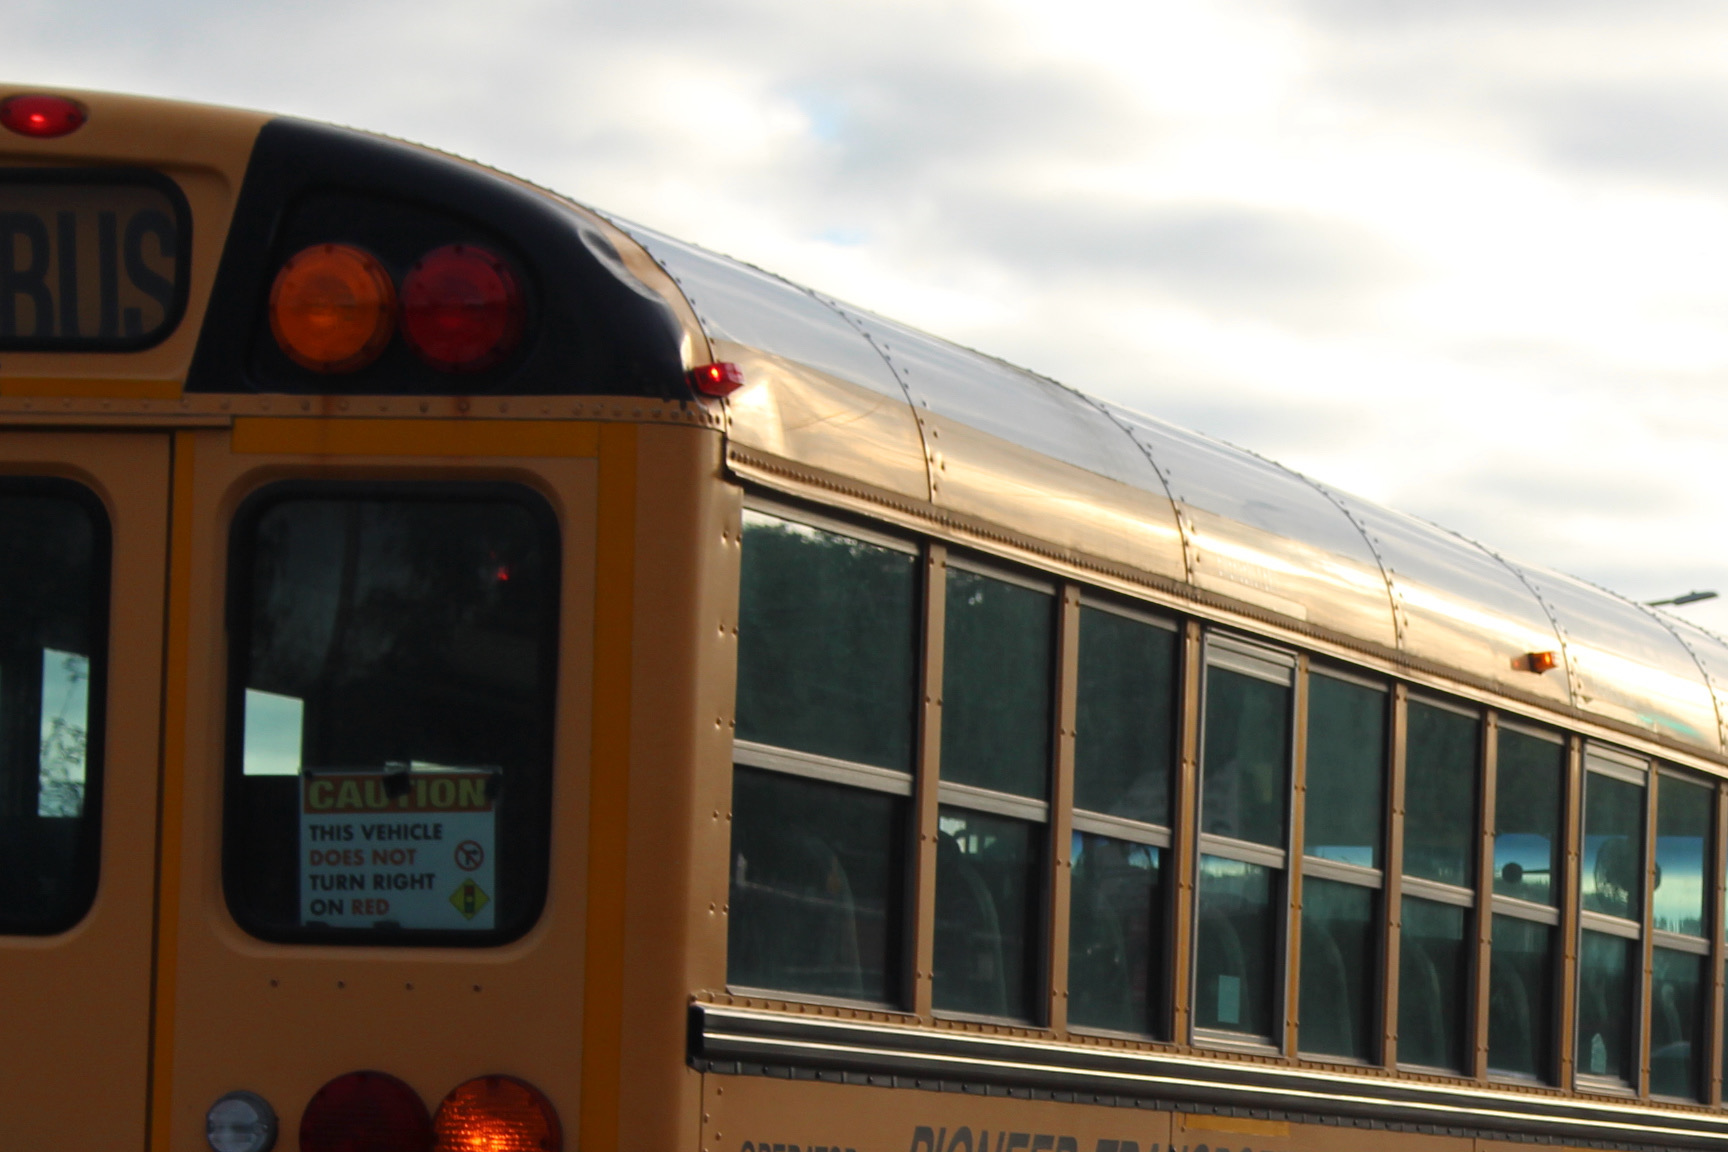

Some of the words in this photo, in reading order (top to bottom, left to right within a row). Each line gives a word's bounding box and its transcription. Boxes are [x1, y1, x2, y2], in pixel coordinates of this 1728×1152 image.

[0, 210, 177, 337] BUS
[309, 824, 354, 841] THIS
[361, 823, 443, 841] VEHICLE
[309, 849, 364, 866] DOES
[372, 849, 416, 866] NOT
[309, 874, 365, 891] TURN
[373, 873, 436, 890] RIGHT
[310, 899, 343, 916] ON
[352, 899, 389, 916] RED
